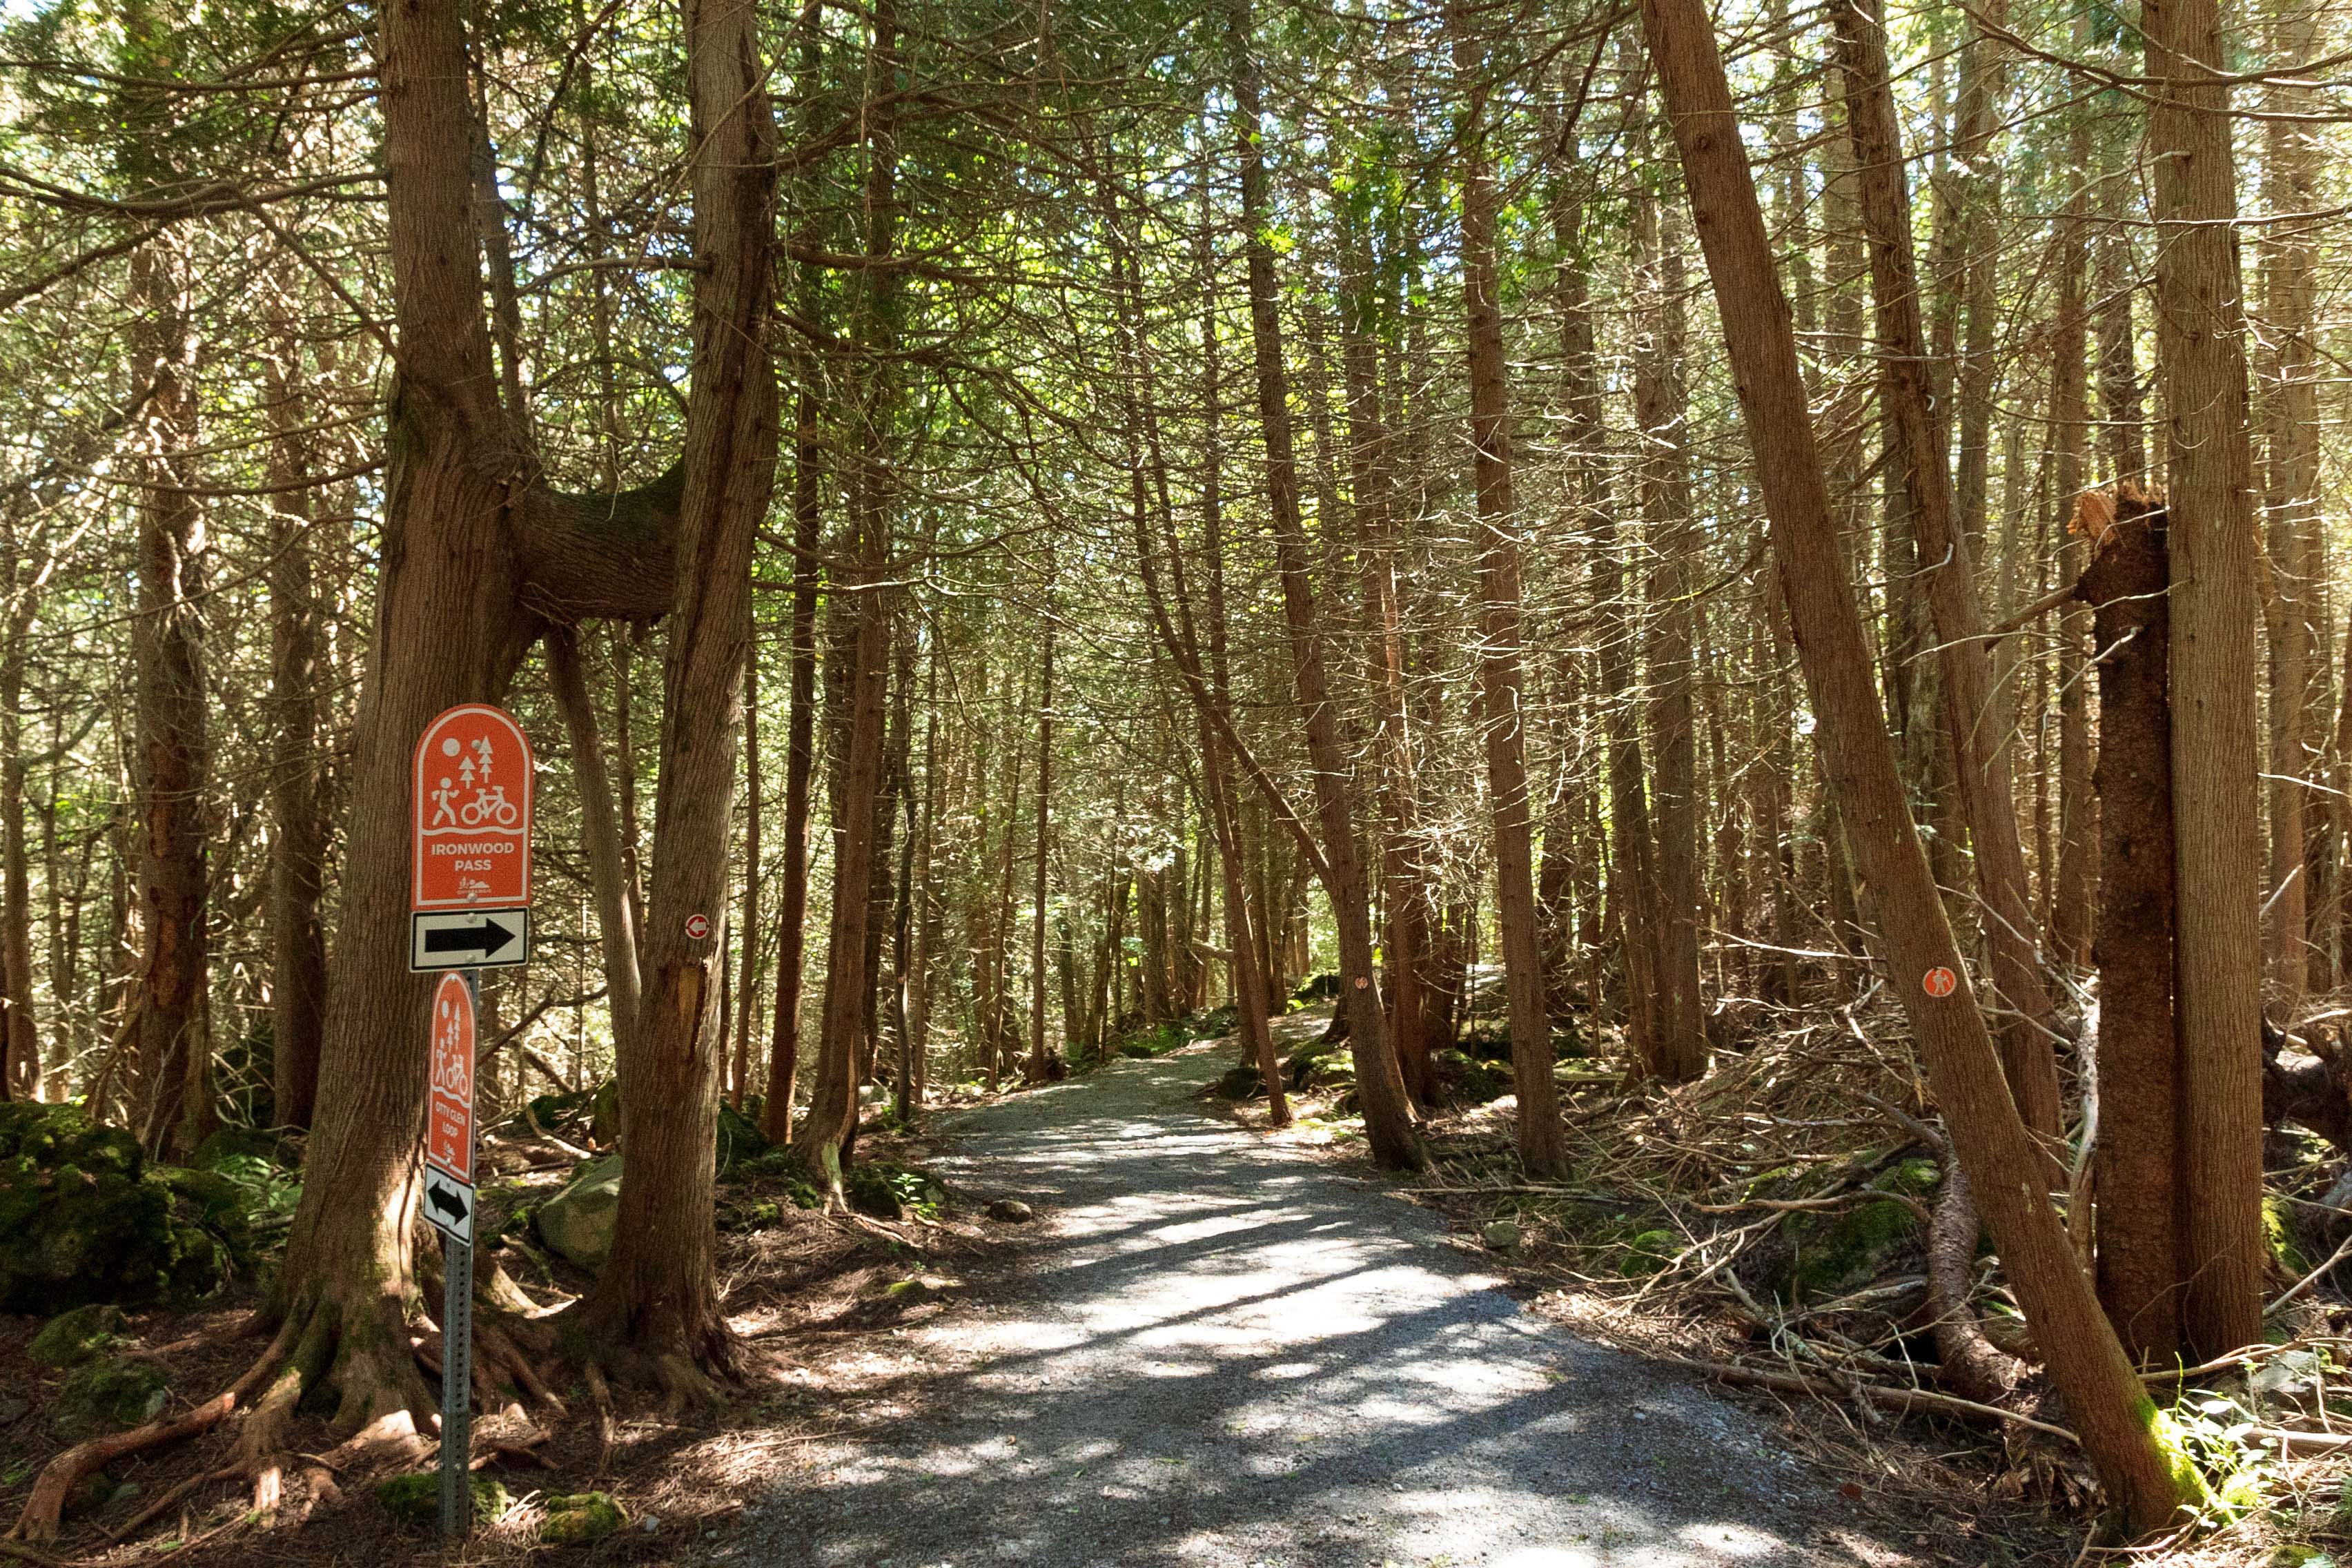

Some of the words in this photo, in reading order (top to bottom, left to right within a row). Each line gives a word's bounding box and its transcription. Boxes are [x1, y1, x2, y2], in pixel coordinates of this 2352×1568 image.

[431, 843, 514, 855] IRONWOOD
[455, 859, 491, 871] PASS
[451, 1108, 465, 1126] GLEN
[442, 1121, 458, 1137] LOOP
